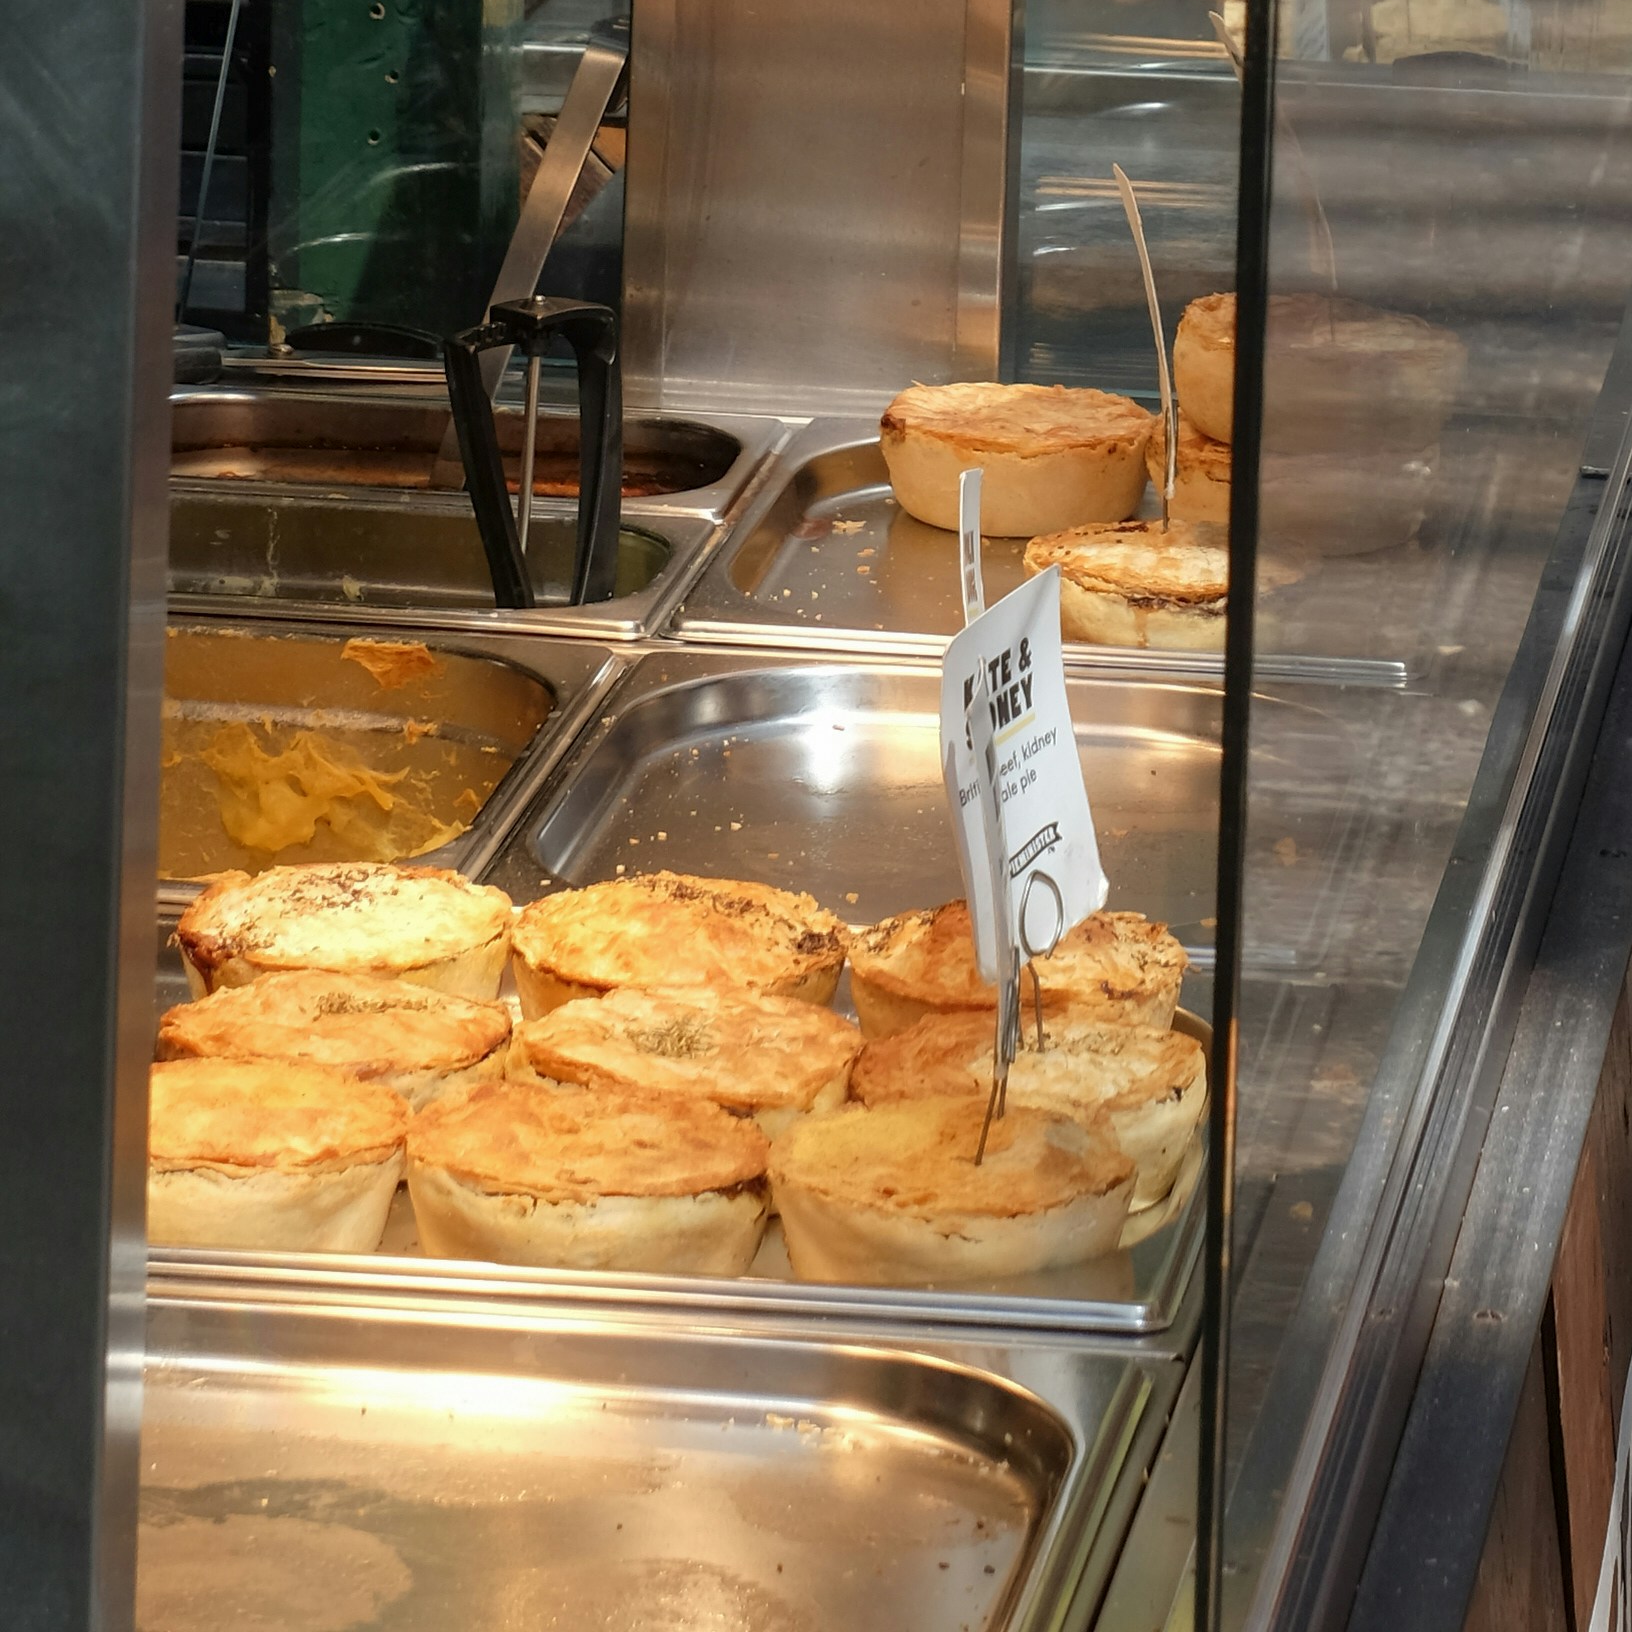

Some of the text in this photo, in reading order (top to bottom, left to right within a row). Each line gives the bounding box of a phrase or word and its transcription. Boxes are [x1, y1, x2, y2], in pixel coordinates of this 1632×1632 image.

[1018, 637, 1033, 673] &
[1000, 750, 1022, 778] eef,
[1021, 727, 1058, 762] kidney
[1020, 767, 1038, 795] pie
